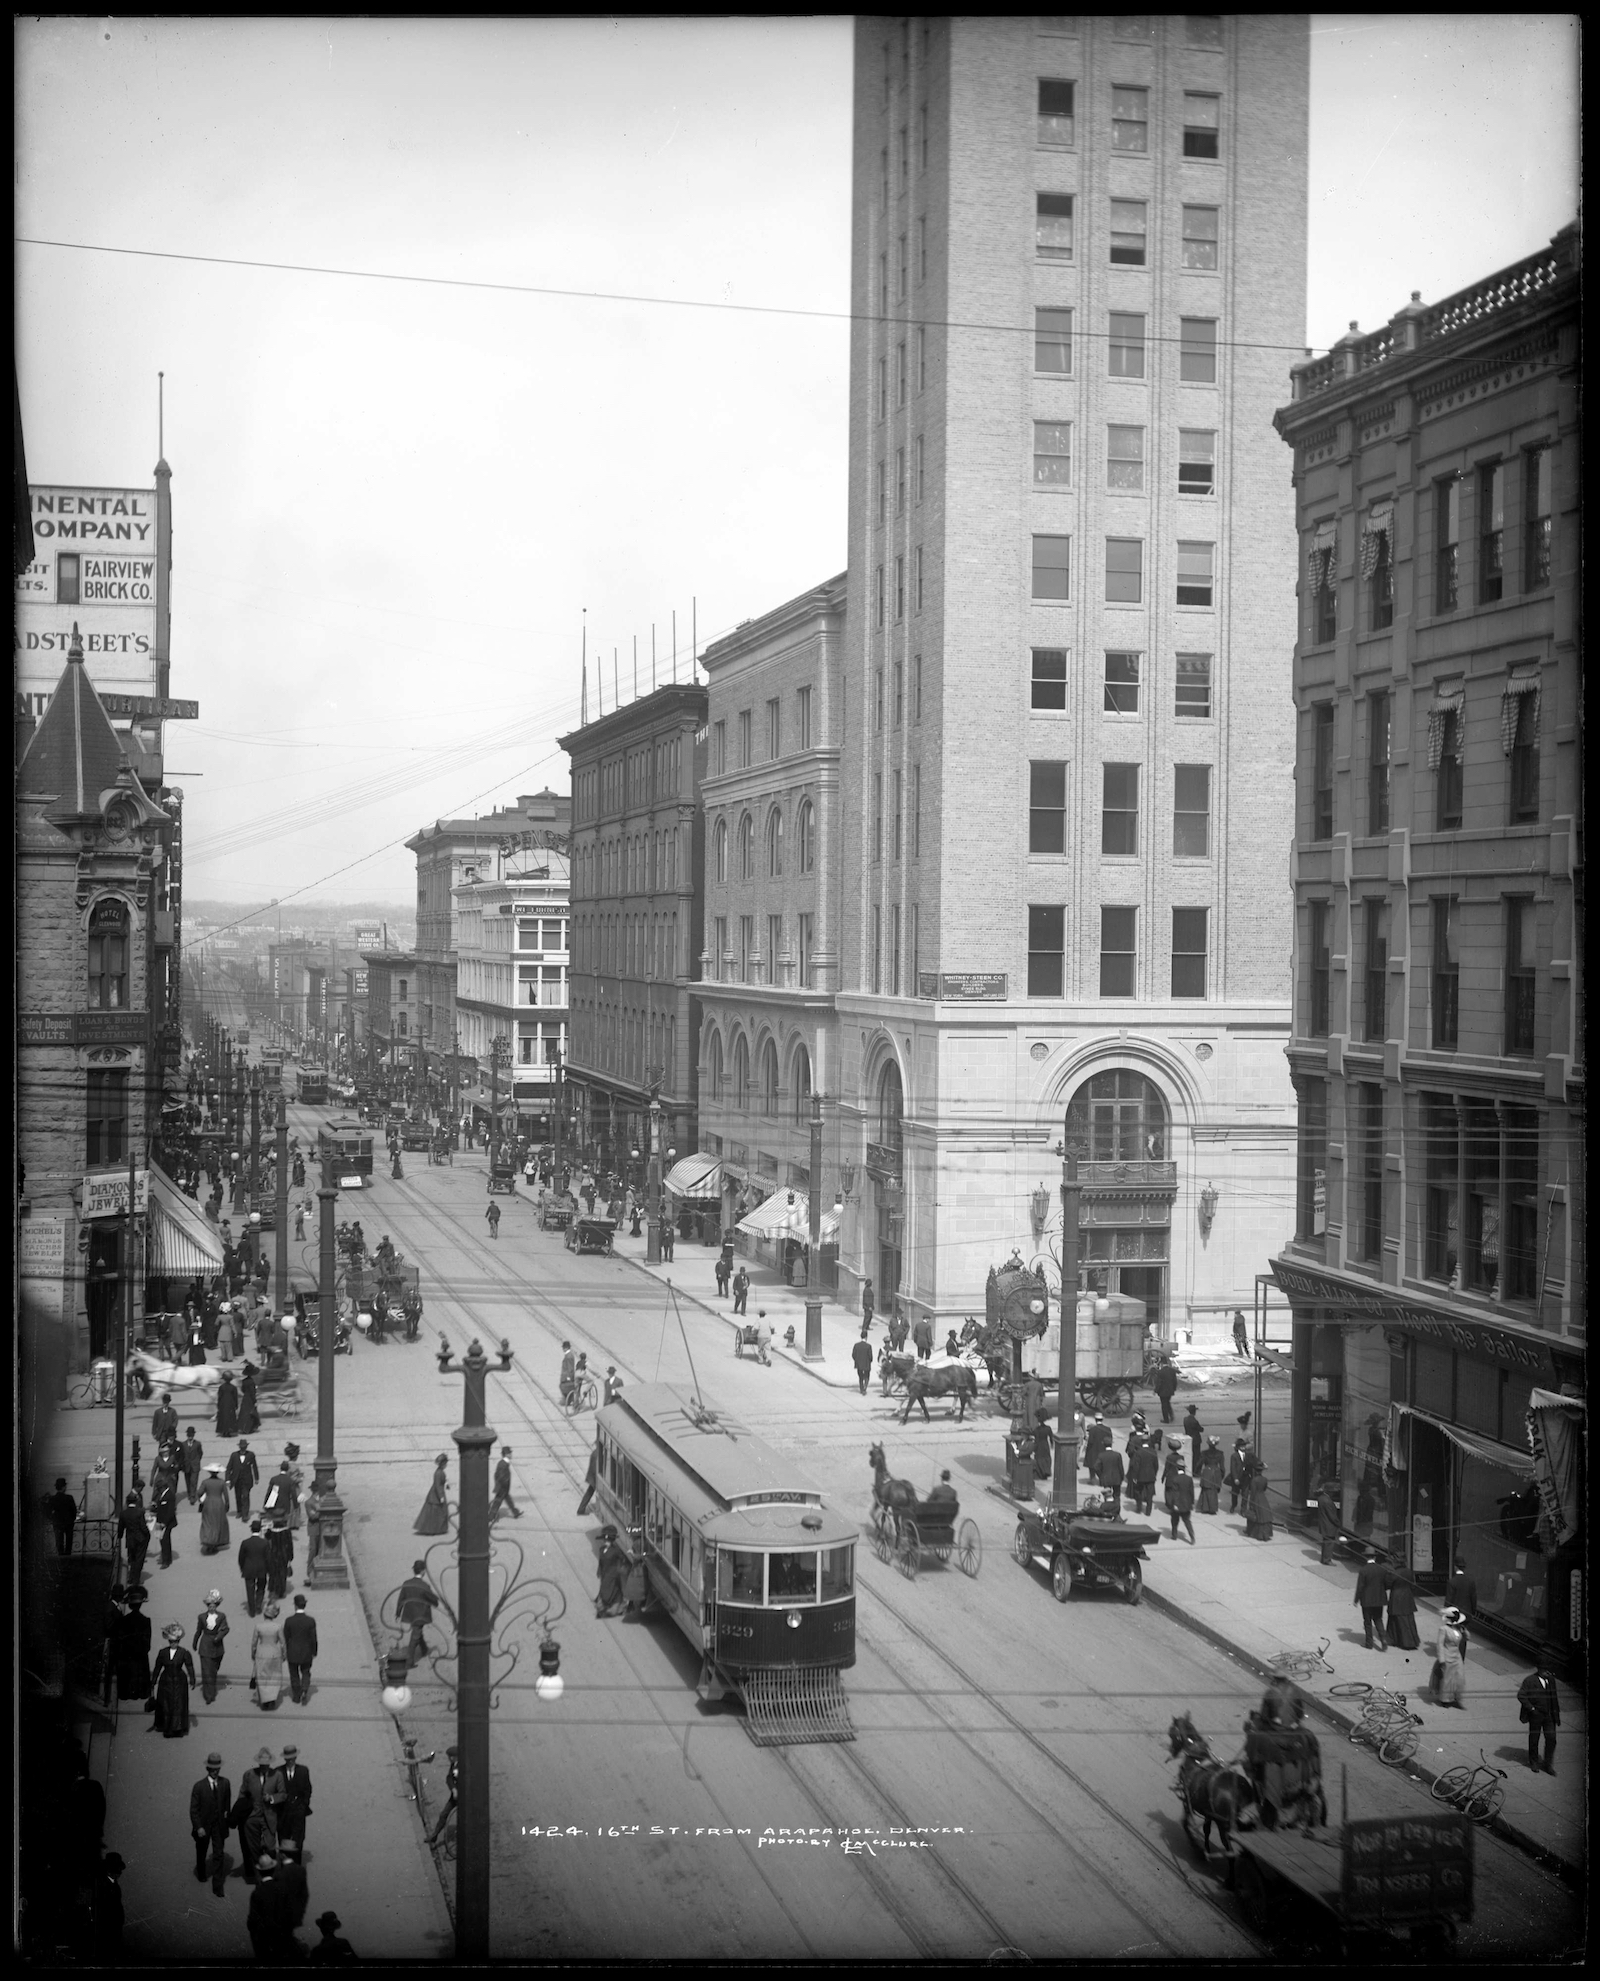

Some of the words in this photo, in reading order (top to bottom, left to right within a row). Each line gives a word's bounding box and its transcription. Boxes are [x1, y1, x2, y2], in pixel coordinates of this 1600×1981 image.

[34, 519, 152, 541] OMPANY
[84, 560, 154, 580] FAIRVIEW
[84, 581, 128, 600] BRICK
[131, 583, 153, 600] CO.
[21, 1018, 43, 1031] Safety
[45, 1017, 72, 1031] Deposit
[114, 1016, 146, 1024] BONDS
[26, 1031, 69, 1040] VAULTS.
[78, 1030, 147, 1039] INVESTMENTS.
[88, 1195, 144, 1211] JEWELY
[1277, 1269, 1358, 1309] BOHM-ALLEN
[1364, 1296, 1386, 1317] CO.
[1445, 1319, 1477, 1350] the
[721, 1623, 754, 1638] 329
